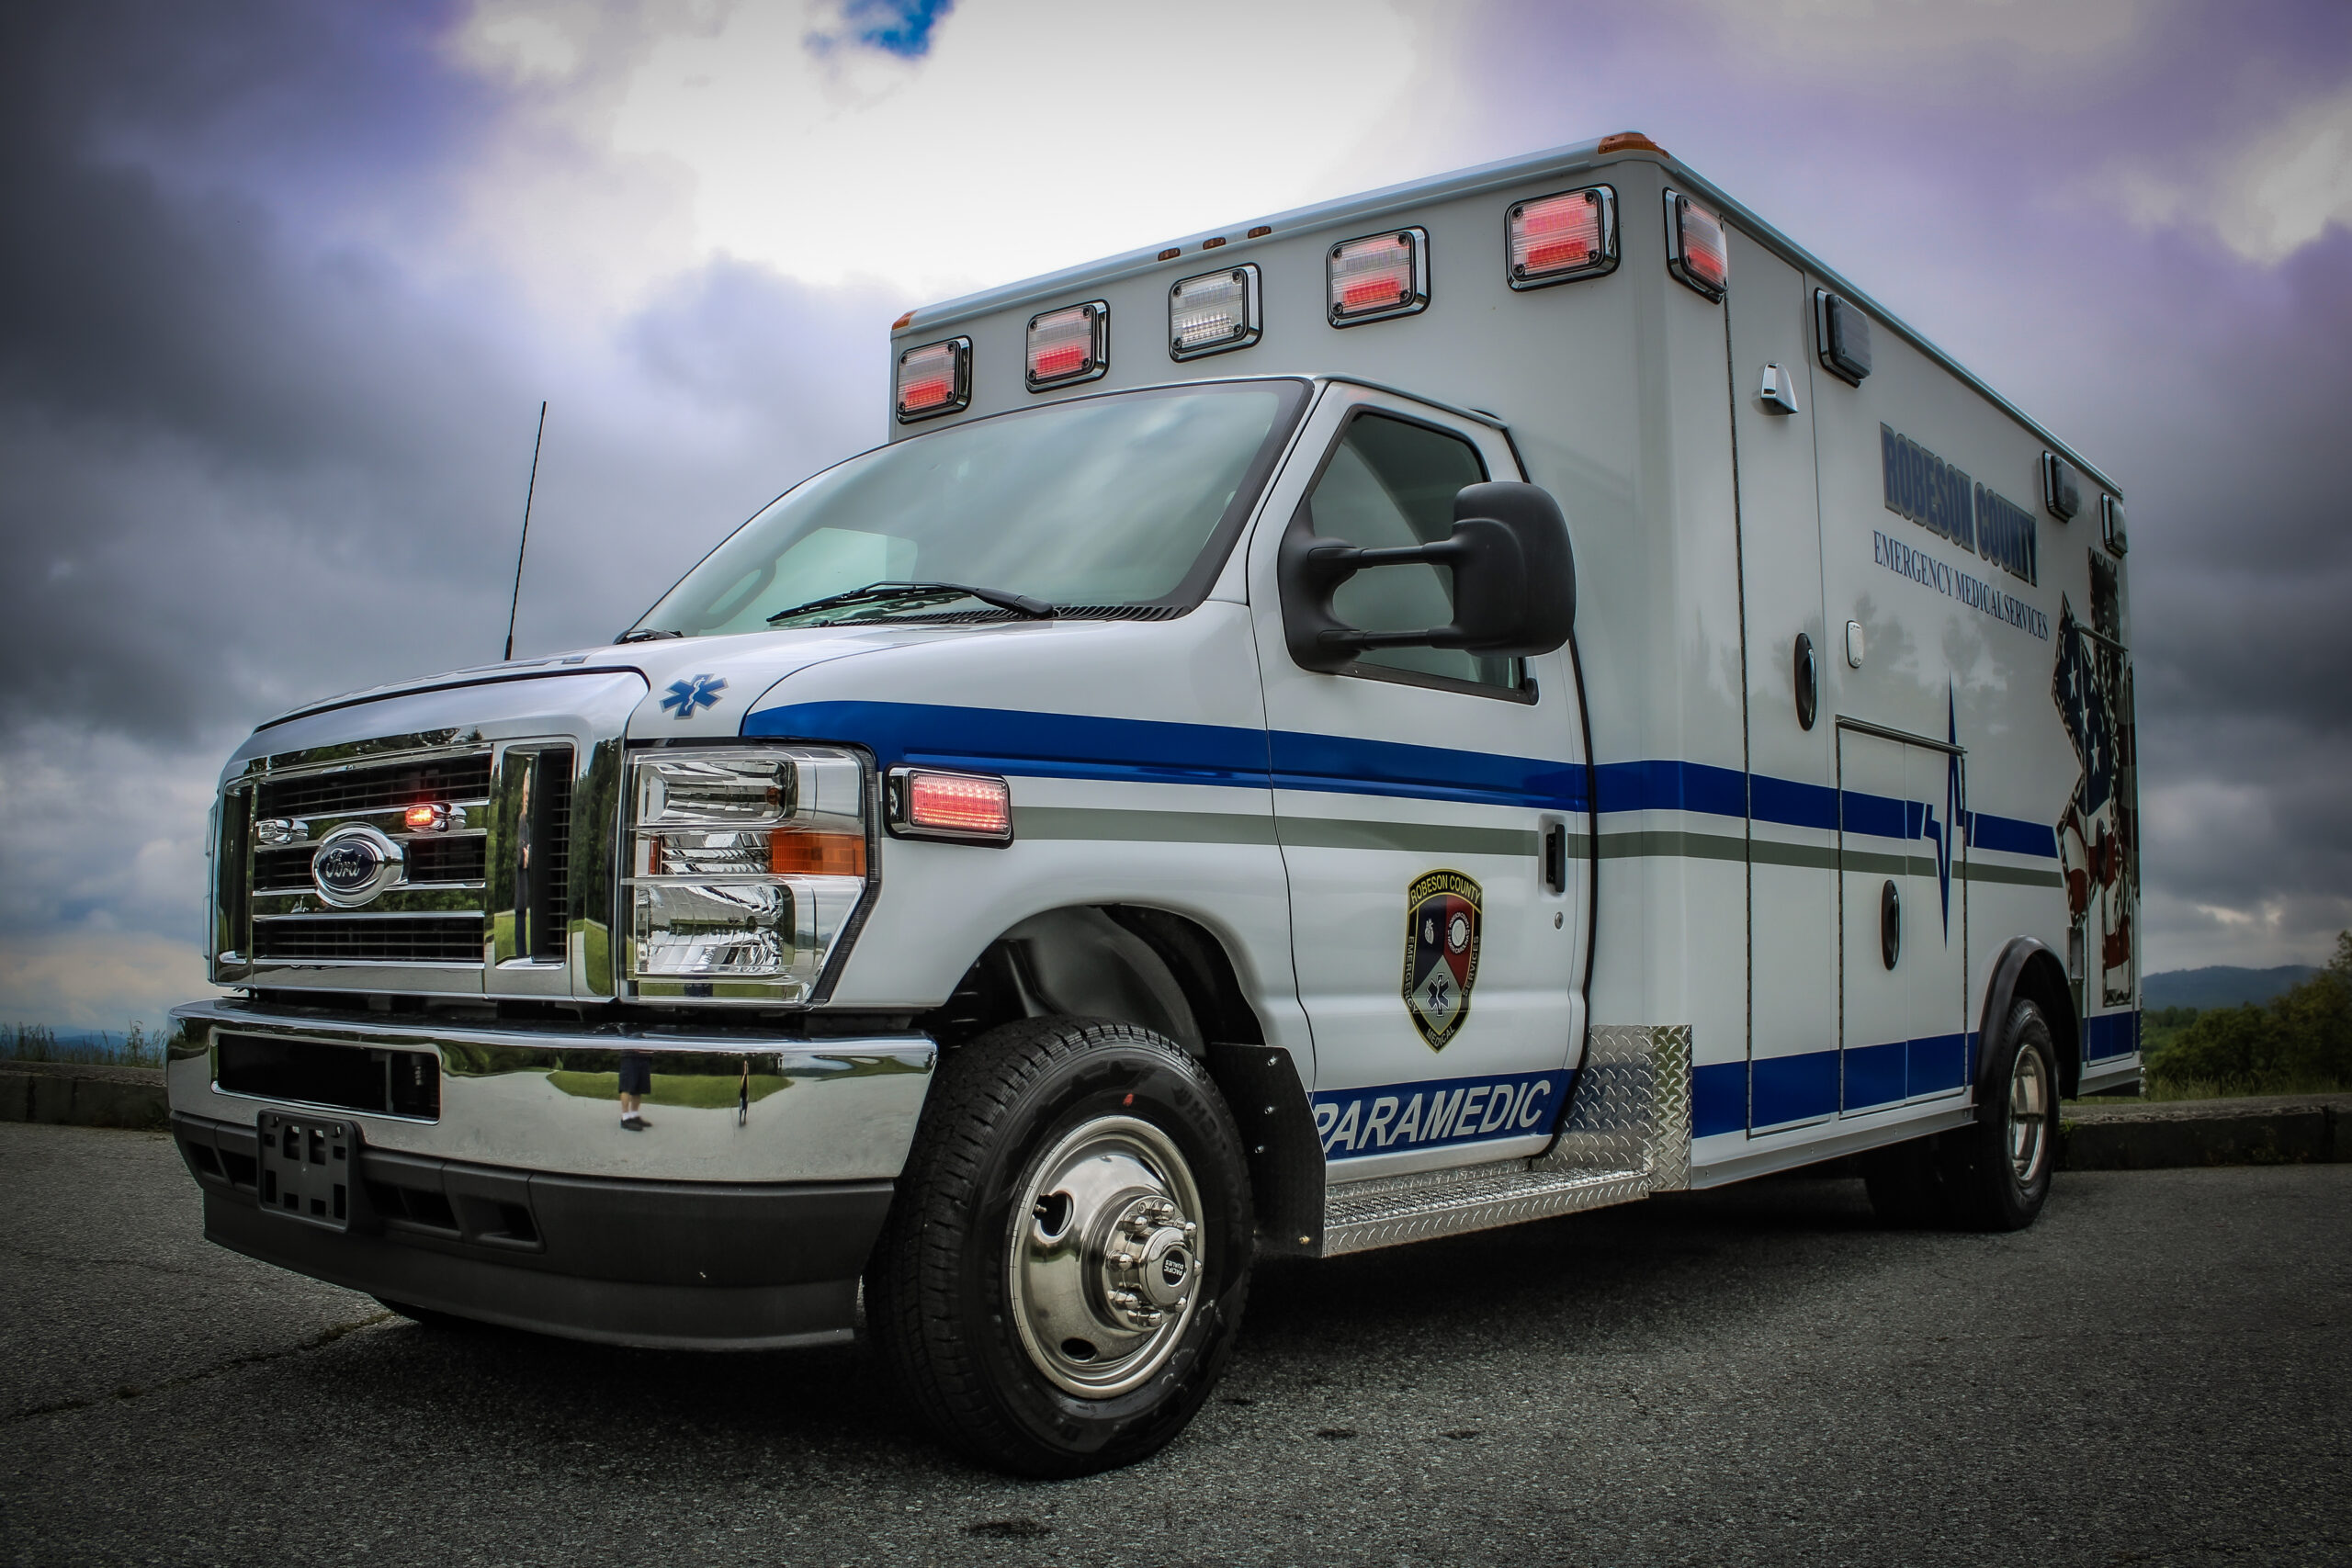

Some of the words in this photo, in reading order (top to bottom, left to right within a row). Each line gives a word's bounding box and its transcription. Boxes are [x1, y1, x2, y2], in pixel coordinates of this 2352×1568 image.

[1880, 422, 1975, 555] ROBESON
[1974, 481, 2038, 588] COUNTY
[1872, 530, 1953, 597] EMERGENCY
[1955, 570, 2005, 621] MEDICAL
[2004, 594, 2049, 641] SERVICES
[325, 848, 362, 878] Ford
[1410, 874, 1448, 905] ROBESON
[1449, 875, 1481, 904] COUNTY
[1404, 935, 1419, 1014] EMERGENCY
[1462, 935, 1479, 997] SERVICES
[1426, 1026, 1455, 1047] MEDICAL
[1313, 1079, 1551, 1154] PARAMEDIC
